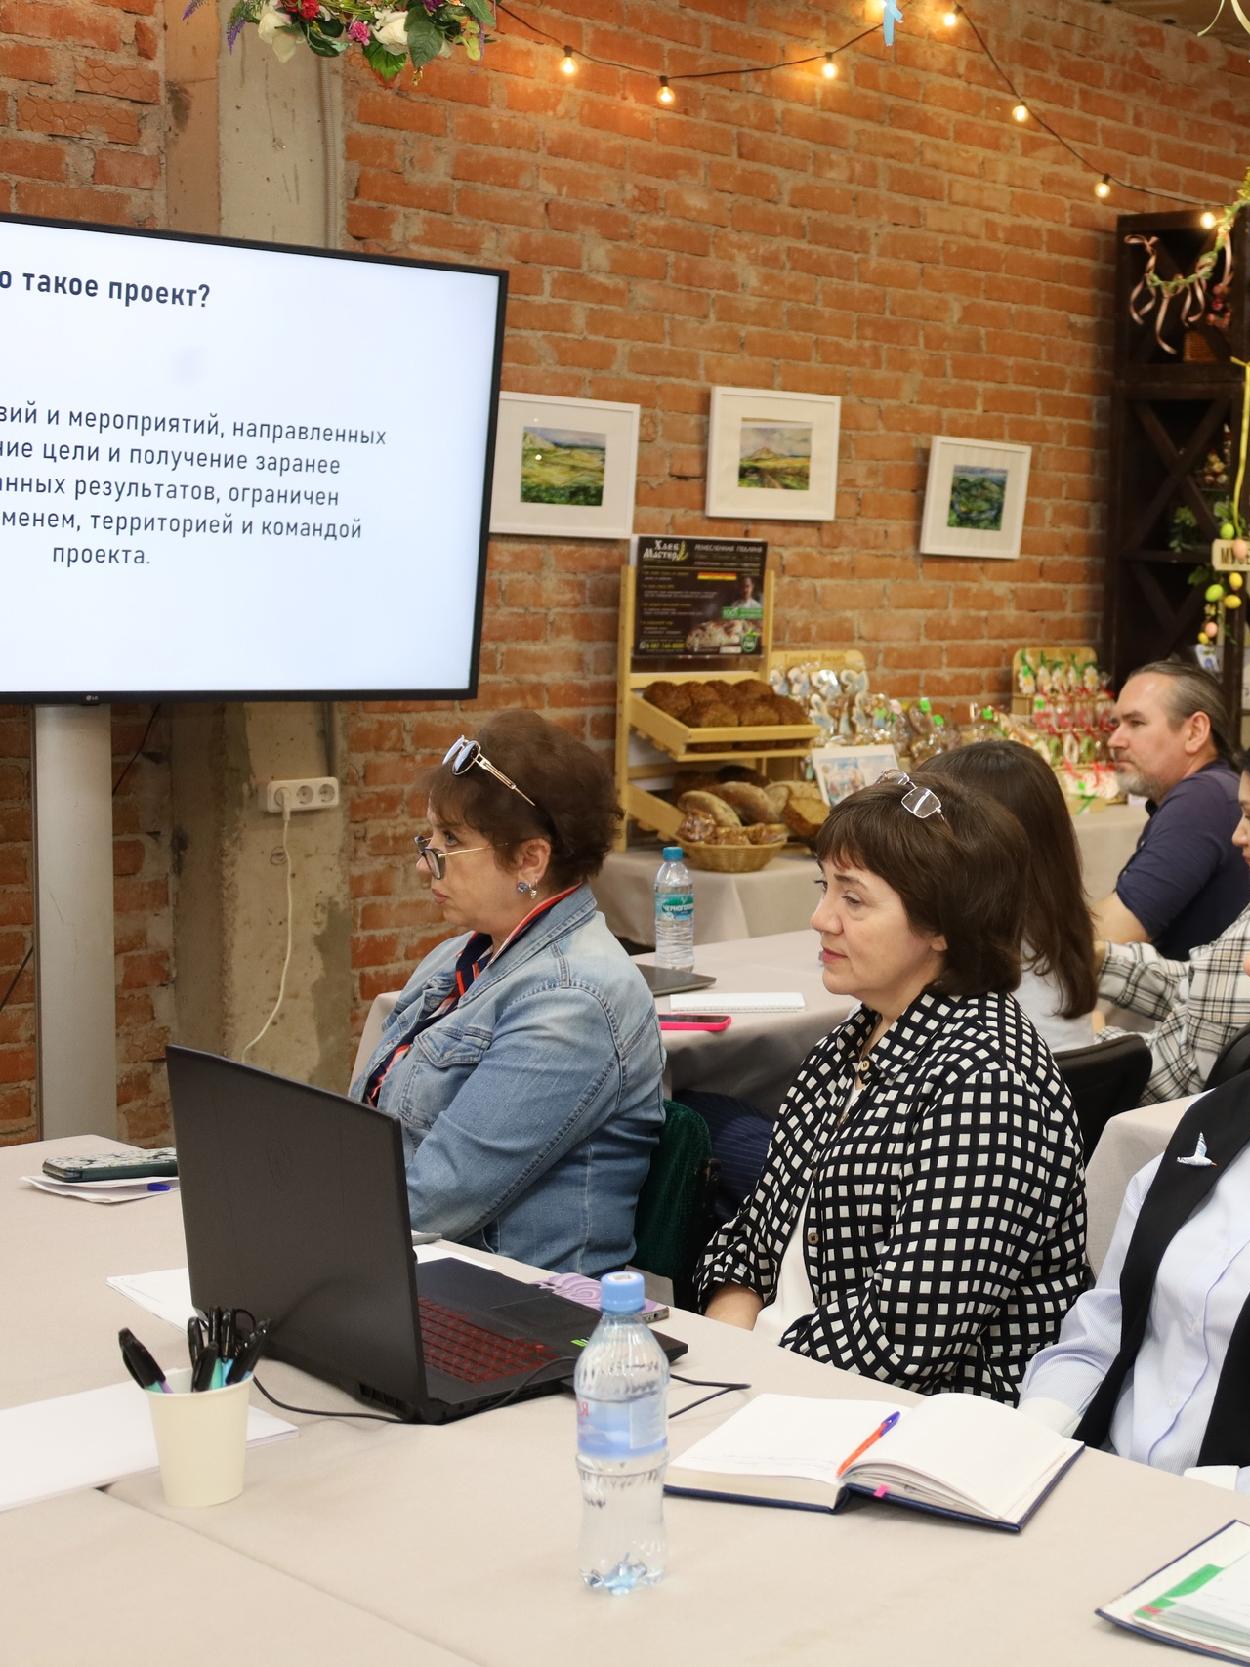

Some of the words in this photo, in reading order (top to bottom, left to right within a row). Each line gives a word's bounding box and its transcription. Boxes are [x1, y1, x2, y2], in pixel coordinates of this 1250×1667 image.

[22, 272, 99, 298] такое
[108, 280, 210, 308] проект?
[47, 408, 60, 426] и
[68, 410, 225, 439] мероприятий,
[232, 418, 387, 446] направленных
[43, 442, 100, 463] цели
[108, 447, 121, 463] и
[129, 447, 248, 472] получение
[255, 454, 341, 477] заранее
[0, 476, 65, 494] нных
[74, 478, 220, 505] результатов,
[228, 486, 339, 508] ограничен
[2, 510, 81, 532] менем,
[90, 512, 233, 538] территорией
[241, 519, 253, 535] и
[261, 513, 361, 541] командой
[52, 546, 151, 568] проекта.
